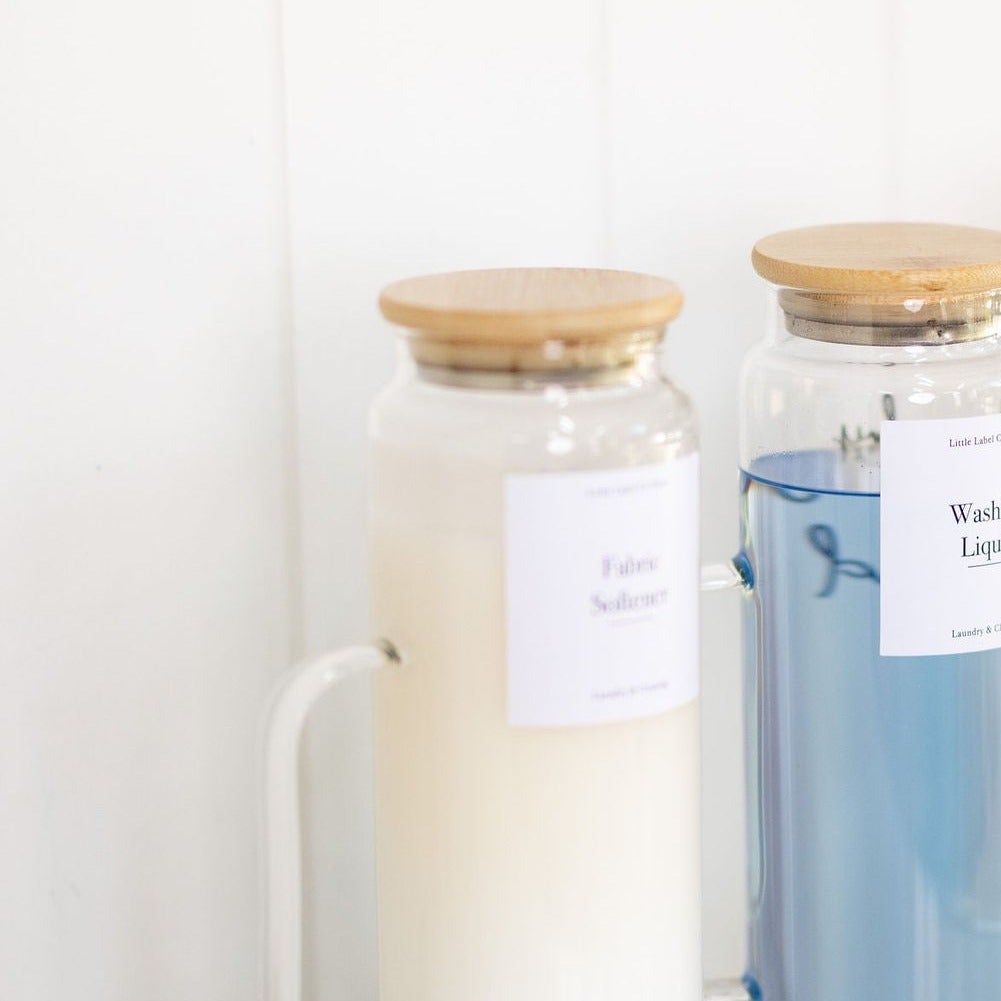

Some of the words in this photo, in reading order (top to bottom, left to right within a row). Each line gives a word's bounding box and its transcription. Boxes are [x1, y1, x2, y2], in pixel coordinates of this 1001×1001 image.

[949, 437, 972, 448] Little
[974, 434, 995, 446] Label
[951, 627, 984, 639] Laundry
[985, 624, 992, 634] &
